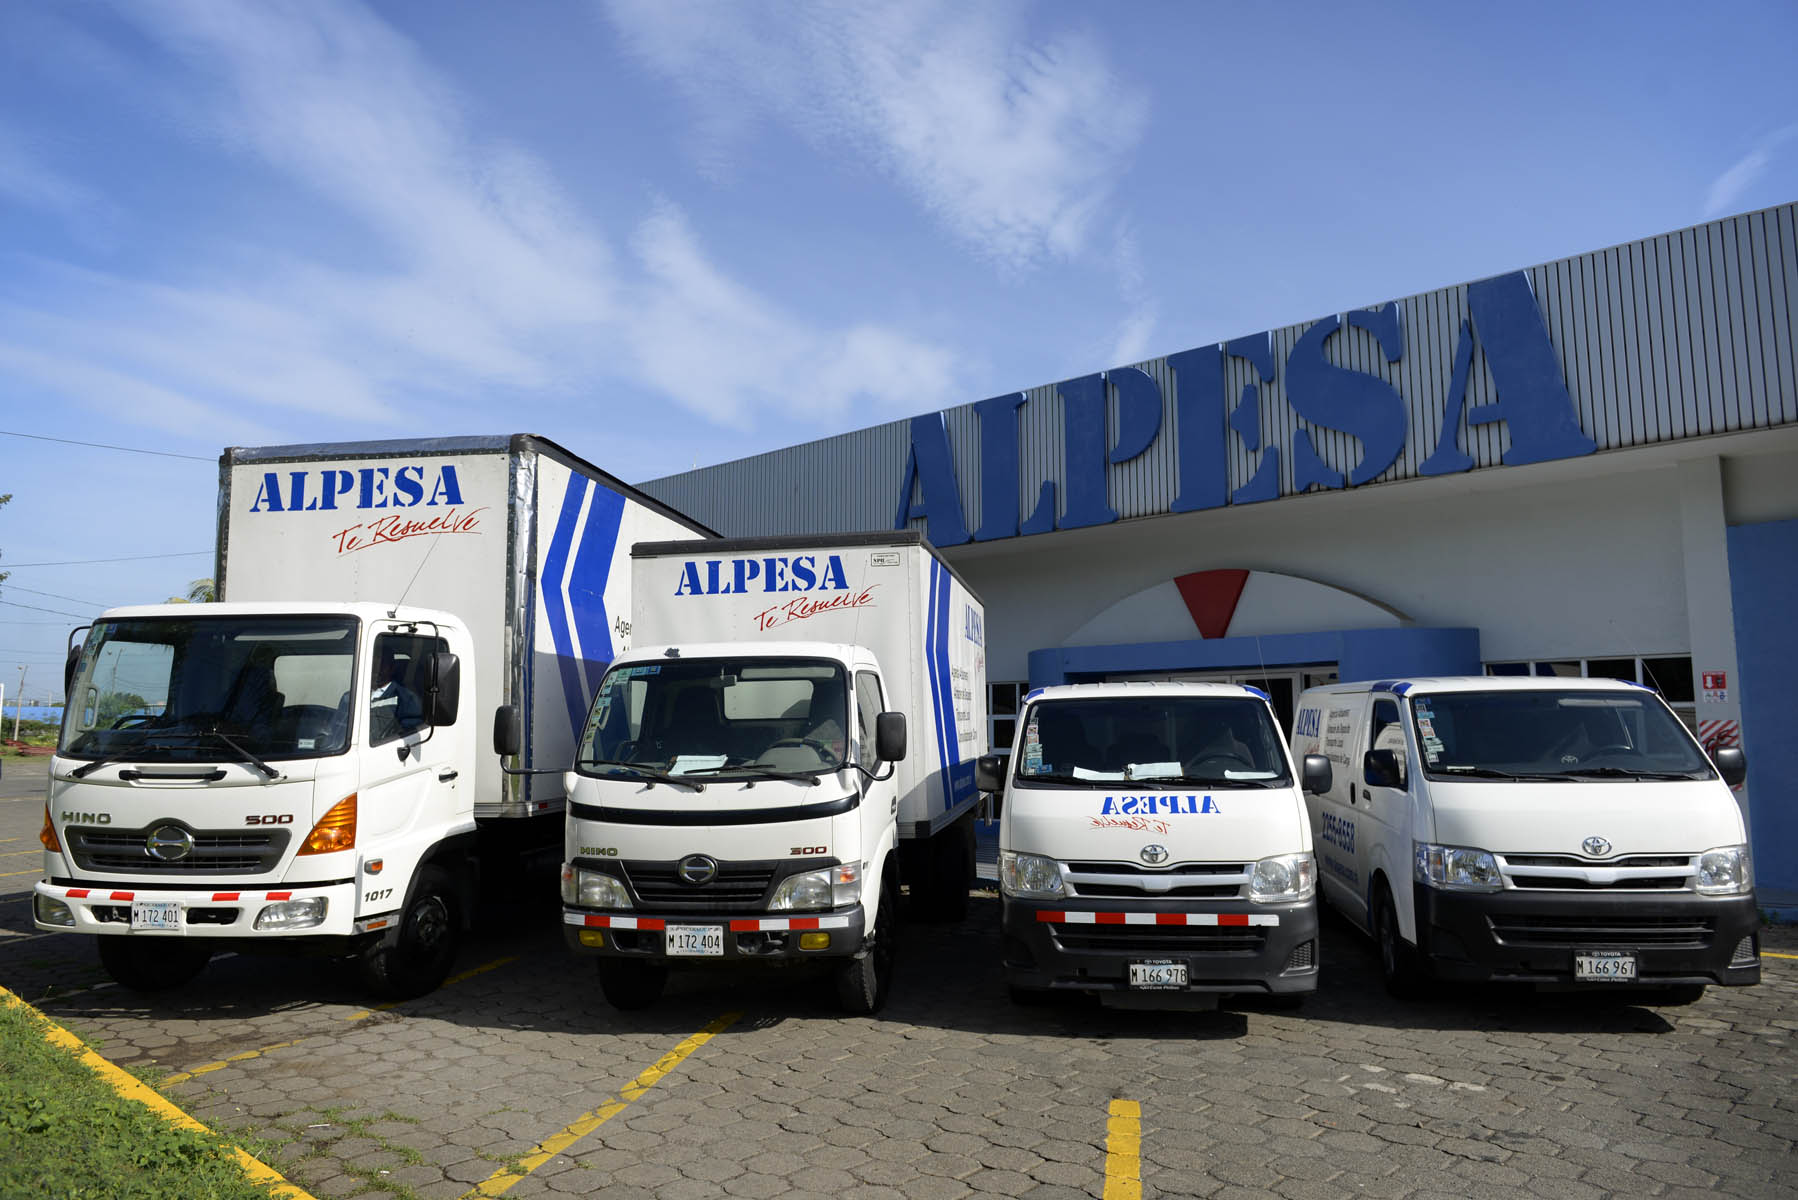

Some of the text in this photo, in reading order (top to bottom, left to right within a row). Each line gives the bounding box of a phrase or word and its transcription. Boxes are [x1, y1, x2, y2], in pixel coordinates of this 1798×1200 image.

[894, 270, 1598, 547] ALPESA
[249, 465, 464, 512] ALPESA
[332, 524, 364, 553] Te
[674, 555, 849, 596] ALPESA
[753, 606, 778, 631] Te
[965, 603, 983, 648] ALPESA
[1296, 708, 1321, 738] ALPESA
[61, 811, 112, 825] HINO
[244, 814, 294, 825] 500
[580, 846, 618, 857] HINO
[365, 888, 393, 902] 1017
[133, 909, 179, 922] M 172 401
[668, 934, 720, 949] M 172 404
[1577, 960, 1635, 975] M 166 967
[1131, 968, 1187, 983] M 166 978
